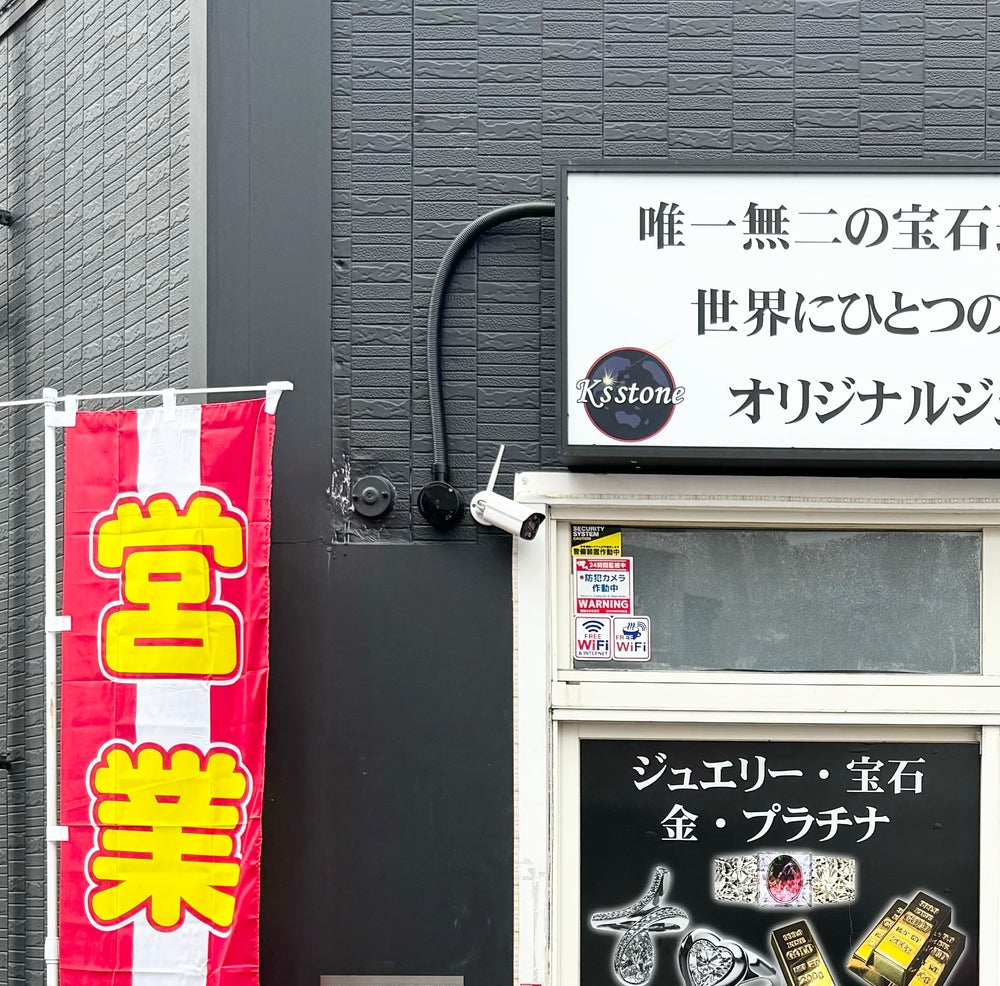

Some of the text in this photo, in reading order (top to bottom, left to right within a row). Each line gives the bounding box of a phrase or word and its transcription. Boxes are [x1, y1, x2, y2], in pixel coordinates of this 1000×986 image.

[573, 548, 620, 556] 警備装置作動中
[584, 573, 626, 583] 防犯カメラ
[592, 583, 619, 593] 作動中
[578, 600, 629, 609] WARNING
[578, 640, 609, 651] WiFi
[616, 642, 646, 652] WiFi
[633, 753, 925, 794] ジュエリー・宝石
[661, 803, 890, 842] 金・プラチナ
